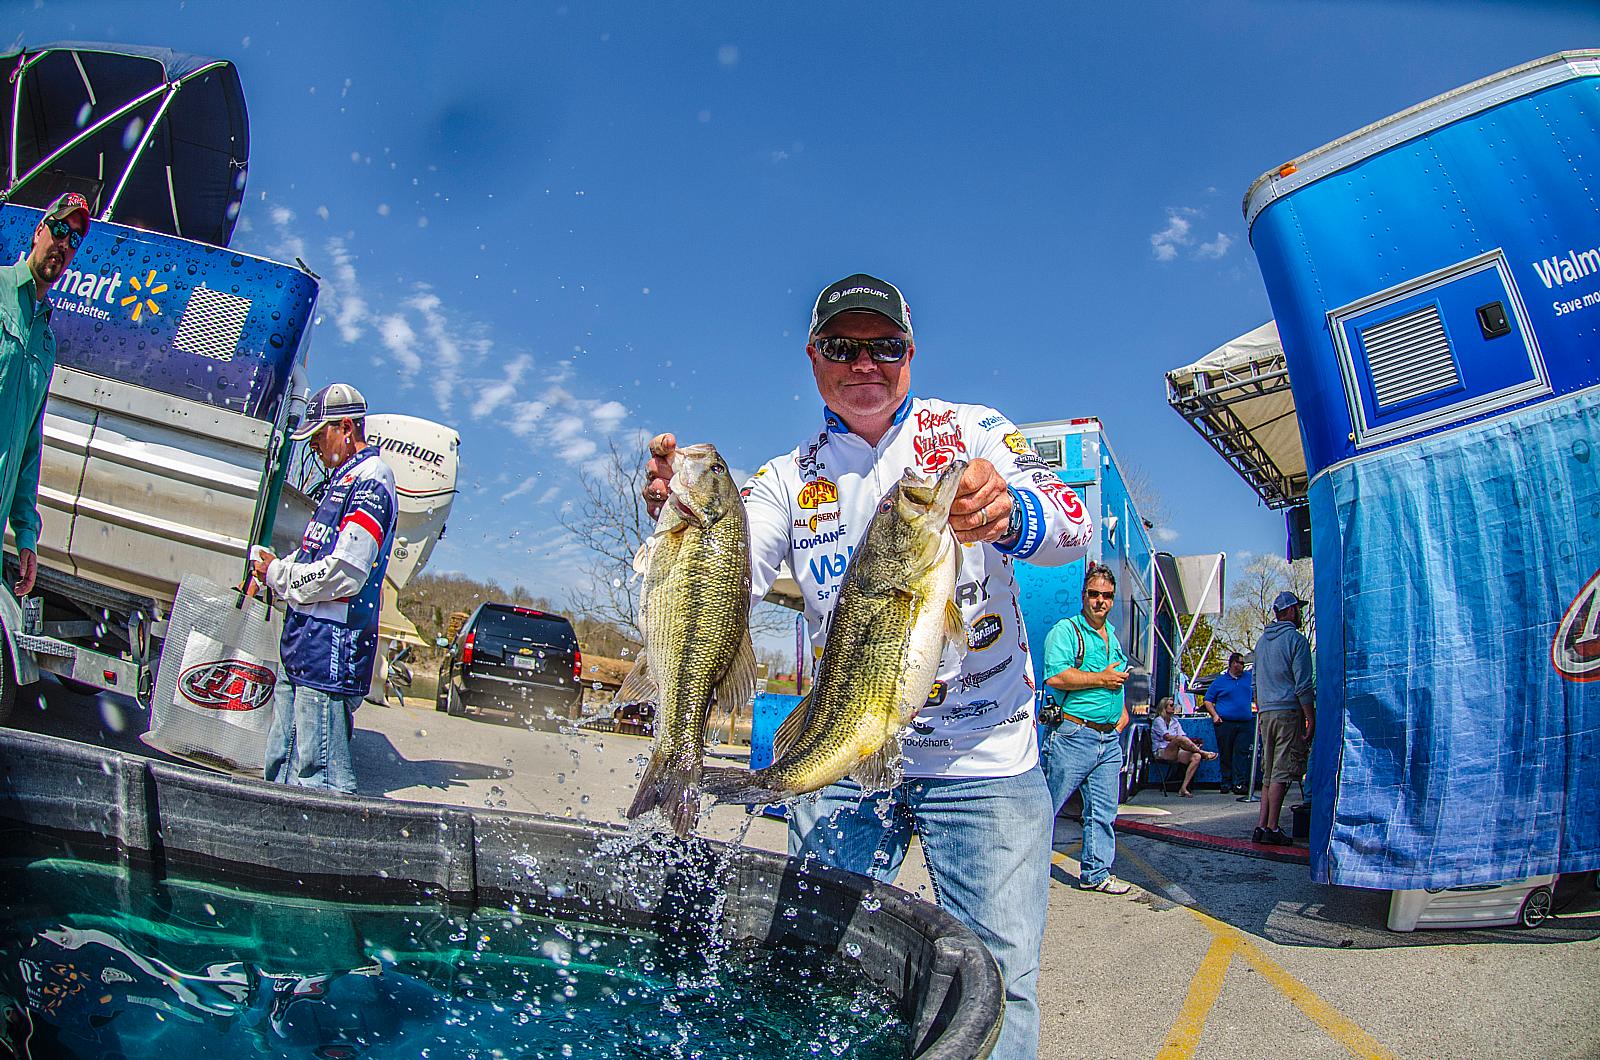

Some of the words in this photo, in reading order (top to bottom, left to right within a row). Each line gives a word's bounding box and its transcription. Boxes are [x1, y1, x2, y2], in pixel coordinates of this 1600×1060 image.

[1532, 247, 1600, 289] Walm
[51, 268, 122, 304] mart
[841, 287, 889, 300] MERCURY
[57, 297, 77, 312] Live
[77, 301, 110, 321] better.
[1552, 298, 1583, 317] Save
[1582, 291, 1600, 307] mo
[366, 434, 445, 467] EVINRUDE
[793, 519, 808, 527] ALL
[329, 625, 341, 681] EVINRUDE
[194, 665, 274, 709] FLW
